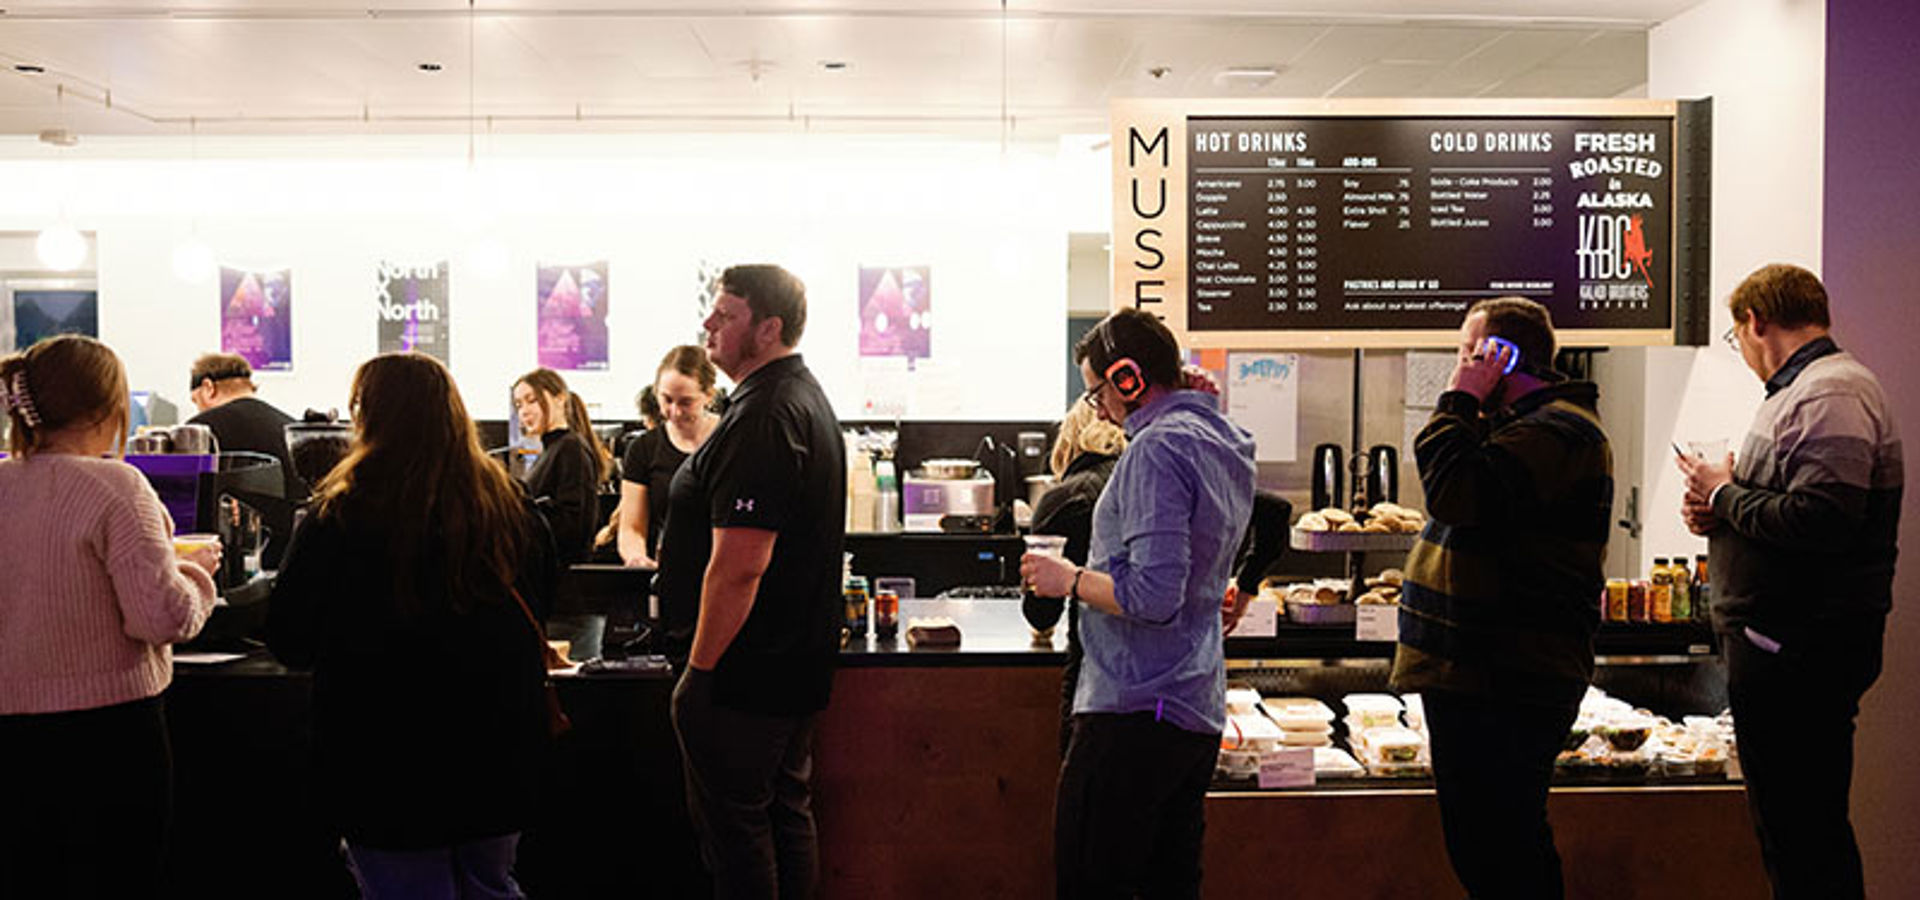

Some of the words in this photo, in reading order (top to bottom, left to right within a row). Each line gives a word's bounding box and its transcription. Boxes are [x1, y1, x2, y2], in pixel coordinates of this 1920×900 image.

[1196, 132, 1231, 151] HOT
[1238, 132, 1306, 151] DRINKS
[1431, 132, 1477, 151] COLD
[1485, 132, 1551, 151] DRINKS
[1575, 133, 1655, 152] FRESH
[1570, 156, 1662, 179] ROASTED
[1196, 180, 1241, 188] Americano
[1483, 178, 1518, 186] Products
[1609, 177, 1621, 190] in
[1431, 191, 1461, 199] Bottled
[1464, 191, 1488, 199] Water
[1577, 193, 1653, 207] ALASKA
[1196, 207, 1218, 216] Latte
[1344, 207, 1365, 215] Extra
[1129, 127, 1169, 319] MUSE
[1196, 221, 1246, 230] Cappuccino
[1431, 218, 1461, 226] Bottled
[1576, 214, 1631, 279] KBC
[1196, 248, 1224, 256] Mocha
[1218, 262, 1239, 270] Latte
[1197, 275, 1212, 283] Hot
[1215, 275, 1256, 283] Chocolate
[1344, 281, 1378, 290] PASTRIES
[377, 299, 439, 321] North
[1361, 302, 1385, 310] about
